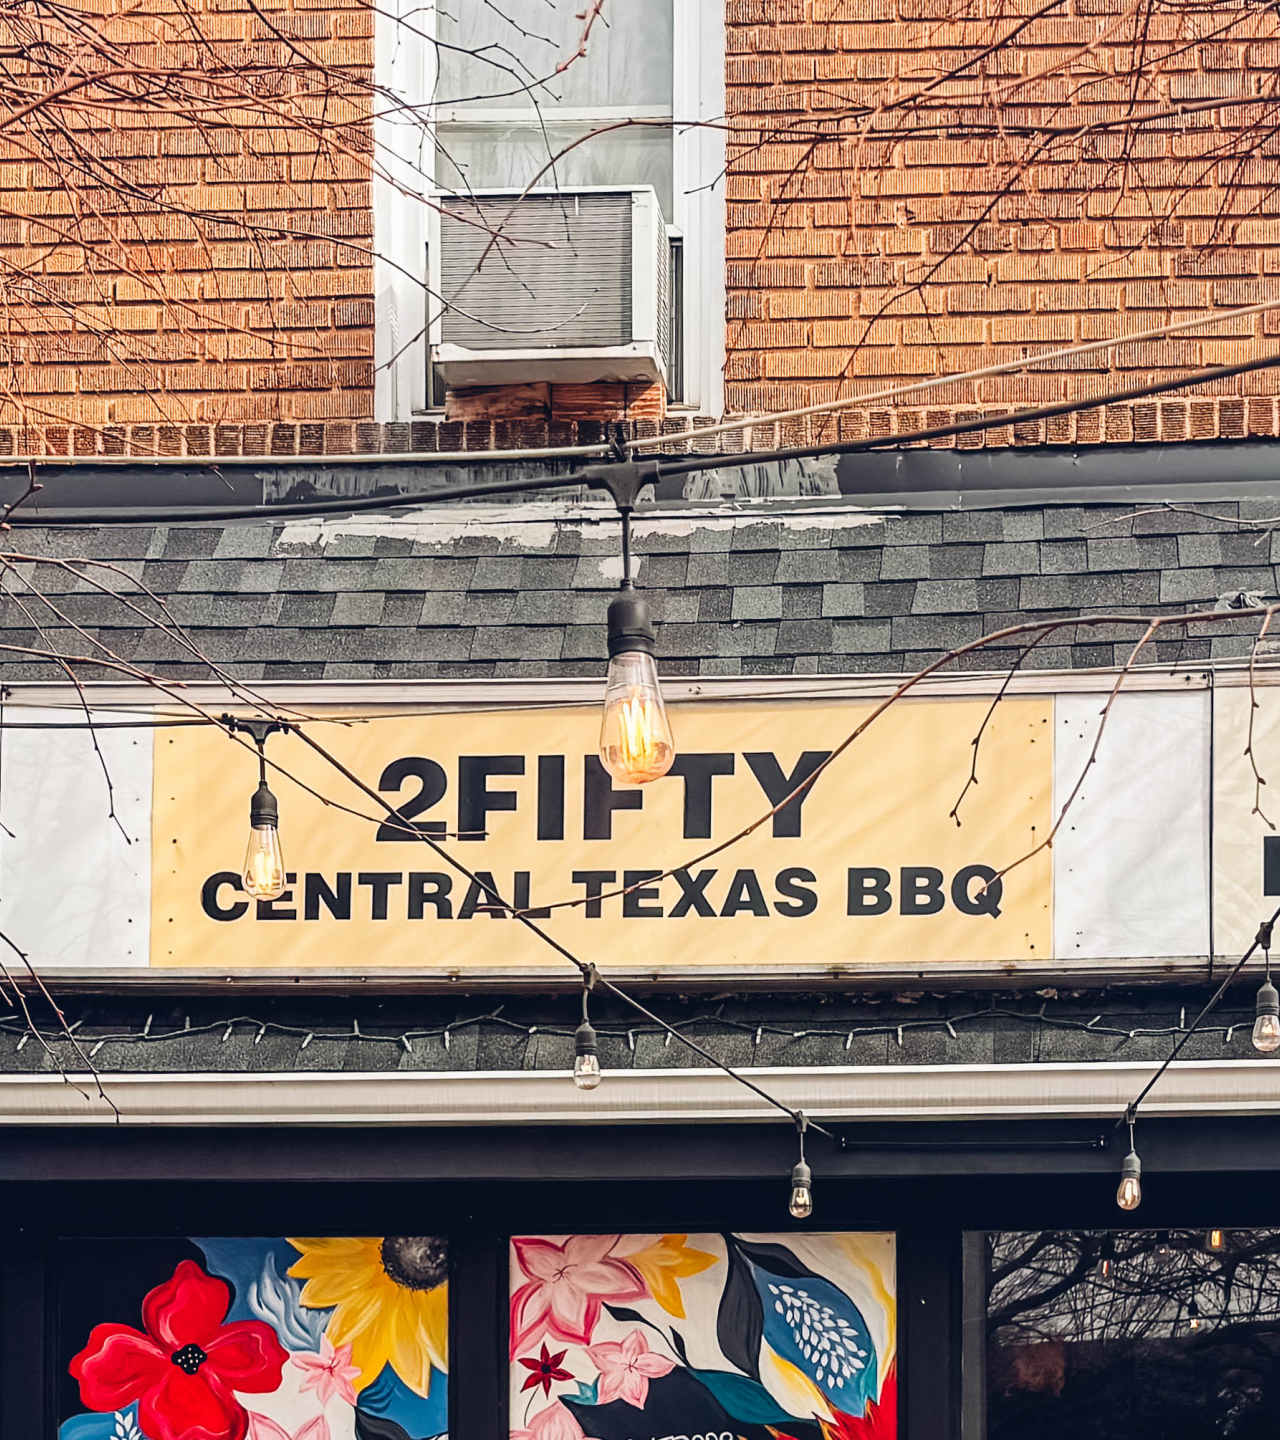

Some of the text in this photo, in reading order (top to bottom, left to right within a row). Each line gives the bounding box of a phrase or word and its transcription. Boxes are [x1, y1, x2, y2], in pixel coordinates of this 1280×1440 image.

[376, 750, 833, 842] 2FIFTY
[201, 864, 1003, 922] CENTRAL TEXAS BBQ
